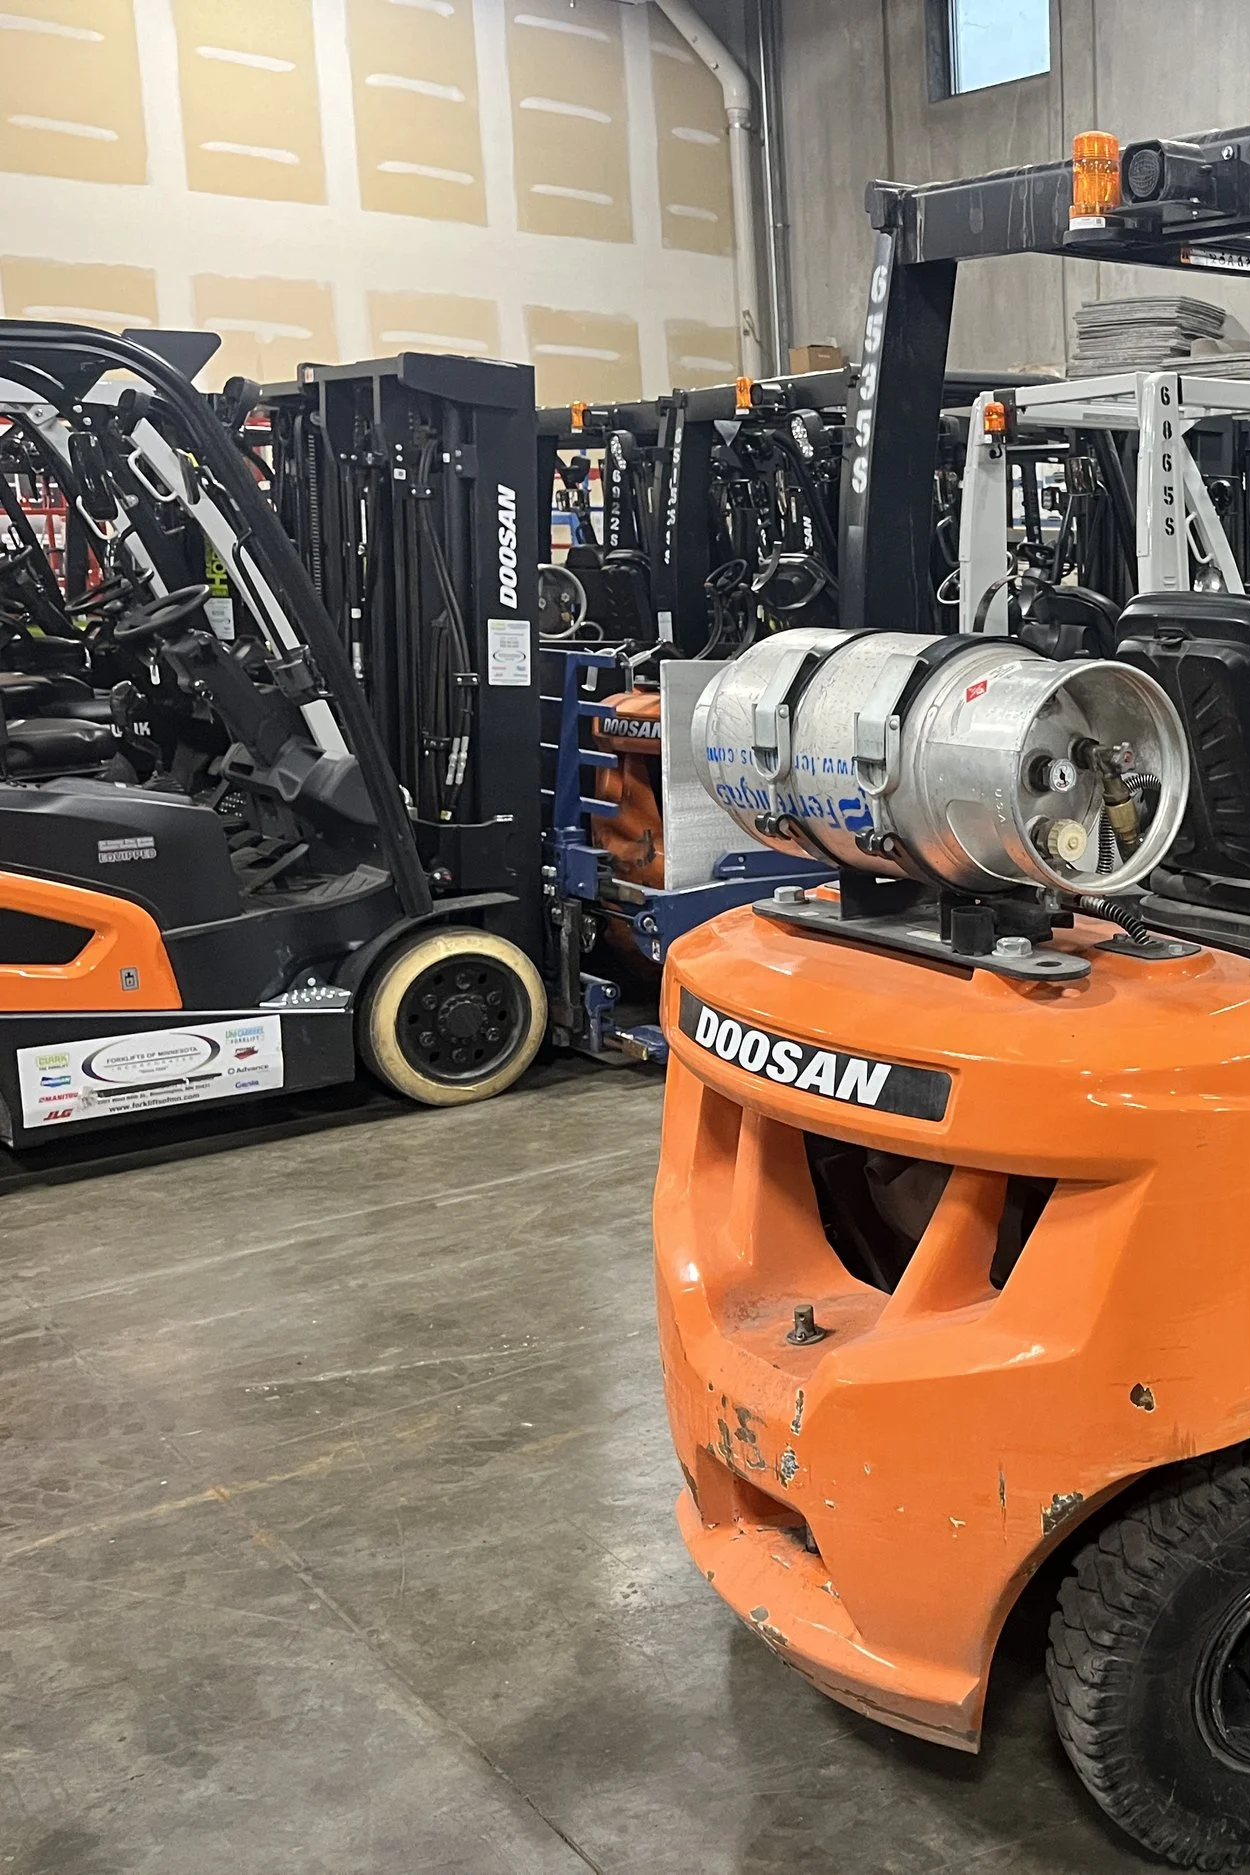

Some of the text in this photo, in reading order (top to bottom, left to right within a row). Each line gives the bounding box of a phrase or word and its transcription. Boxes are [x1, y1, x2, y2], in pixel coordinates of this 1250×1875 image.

[851, 264, 889, 494] 6535S
[497, 483, 518, 610] DOOSAN
[106, 1053, 145, 1064] FORKLIFTS
[157, 1046, 198, 1056] MINNESOTA
[695, 1005, 892, 1106] DOOSAN
[43, 1108, 73, 1121] JLG
